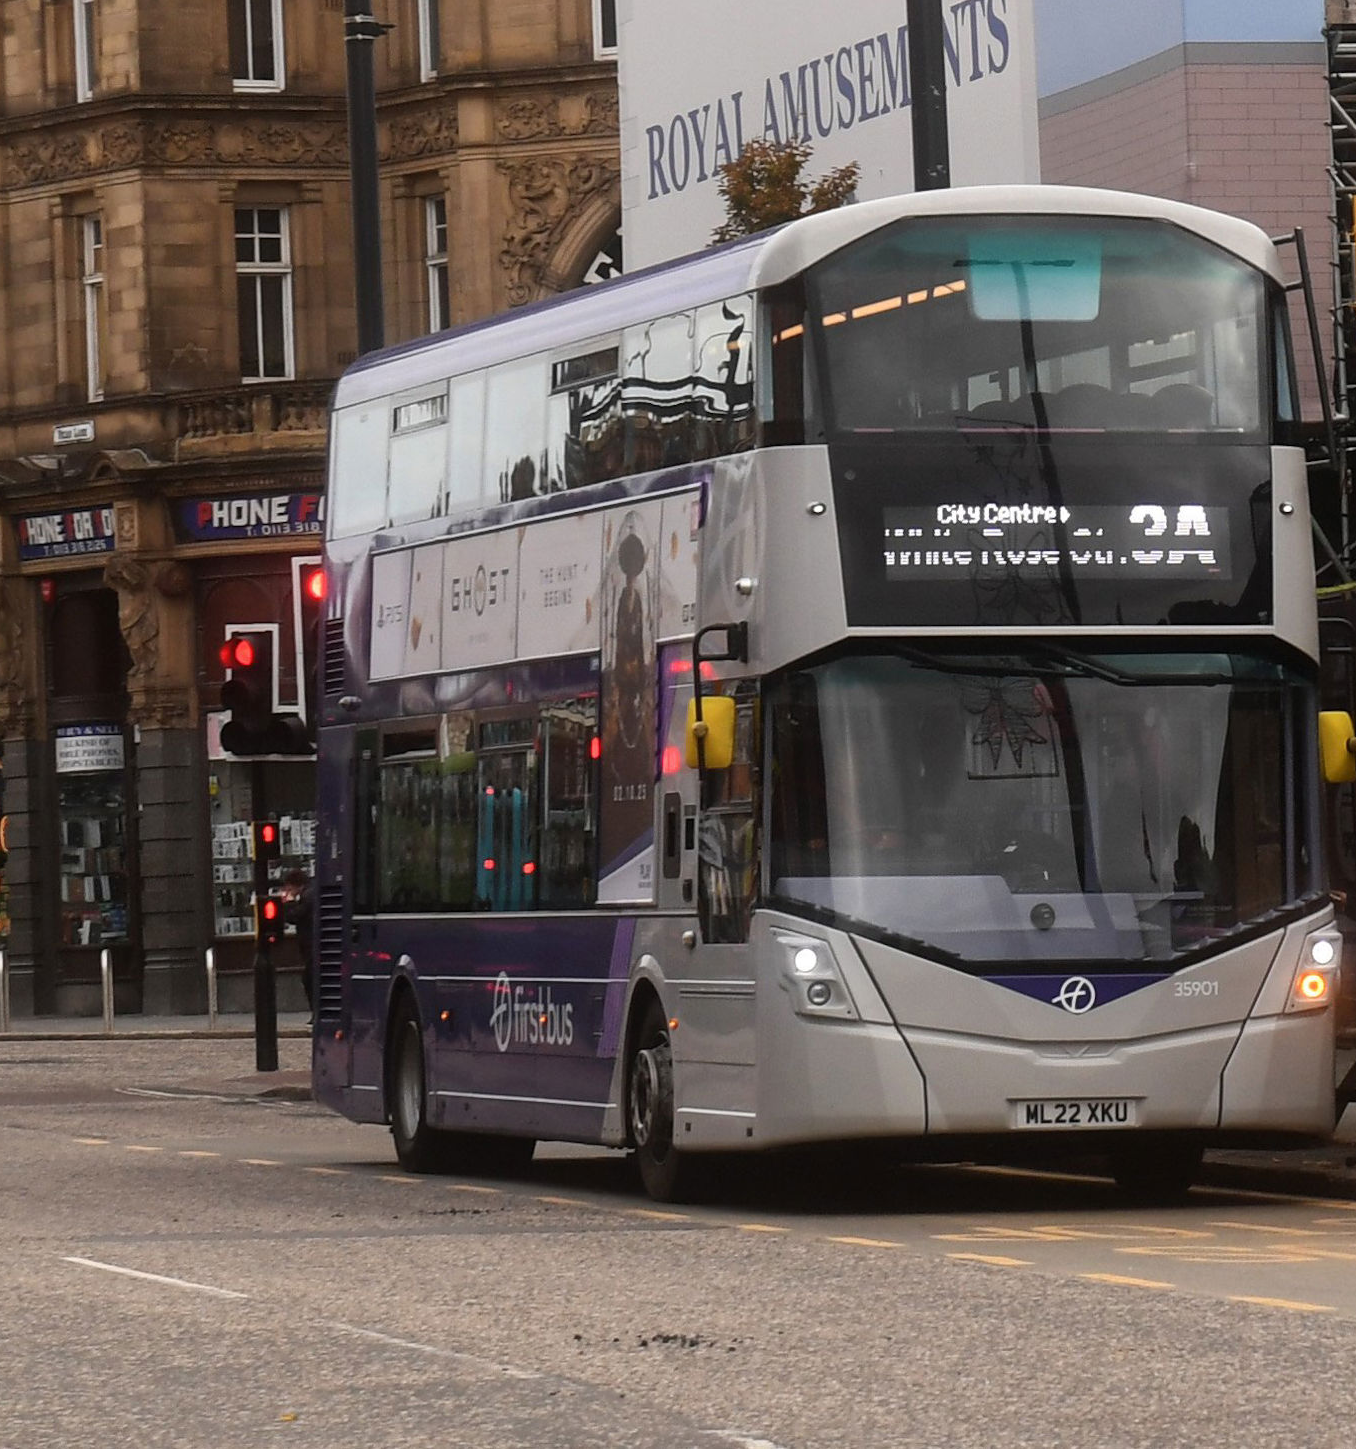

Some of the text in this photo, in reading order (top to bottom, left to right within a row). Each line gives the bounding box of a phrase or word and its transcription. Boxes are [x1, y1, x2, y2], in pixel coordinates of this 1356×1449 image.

[646, 91, 744, 200] ROYAL
[198, 496, 291, 528] PHONE
[937, 503, 979, 525] City
[984, 503, 1057, 524] Centre
[261, 523, 291, 536] 0113
[295, 521, 321, 533] 318
[451, 565, 509, 616] GHOST
[1174, 981, 1219, 997] 35901
[1026, 1102, 1128, 1124] ML22 XKU
